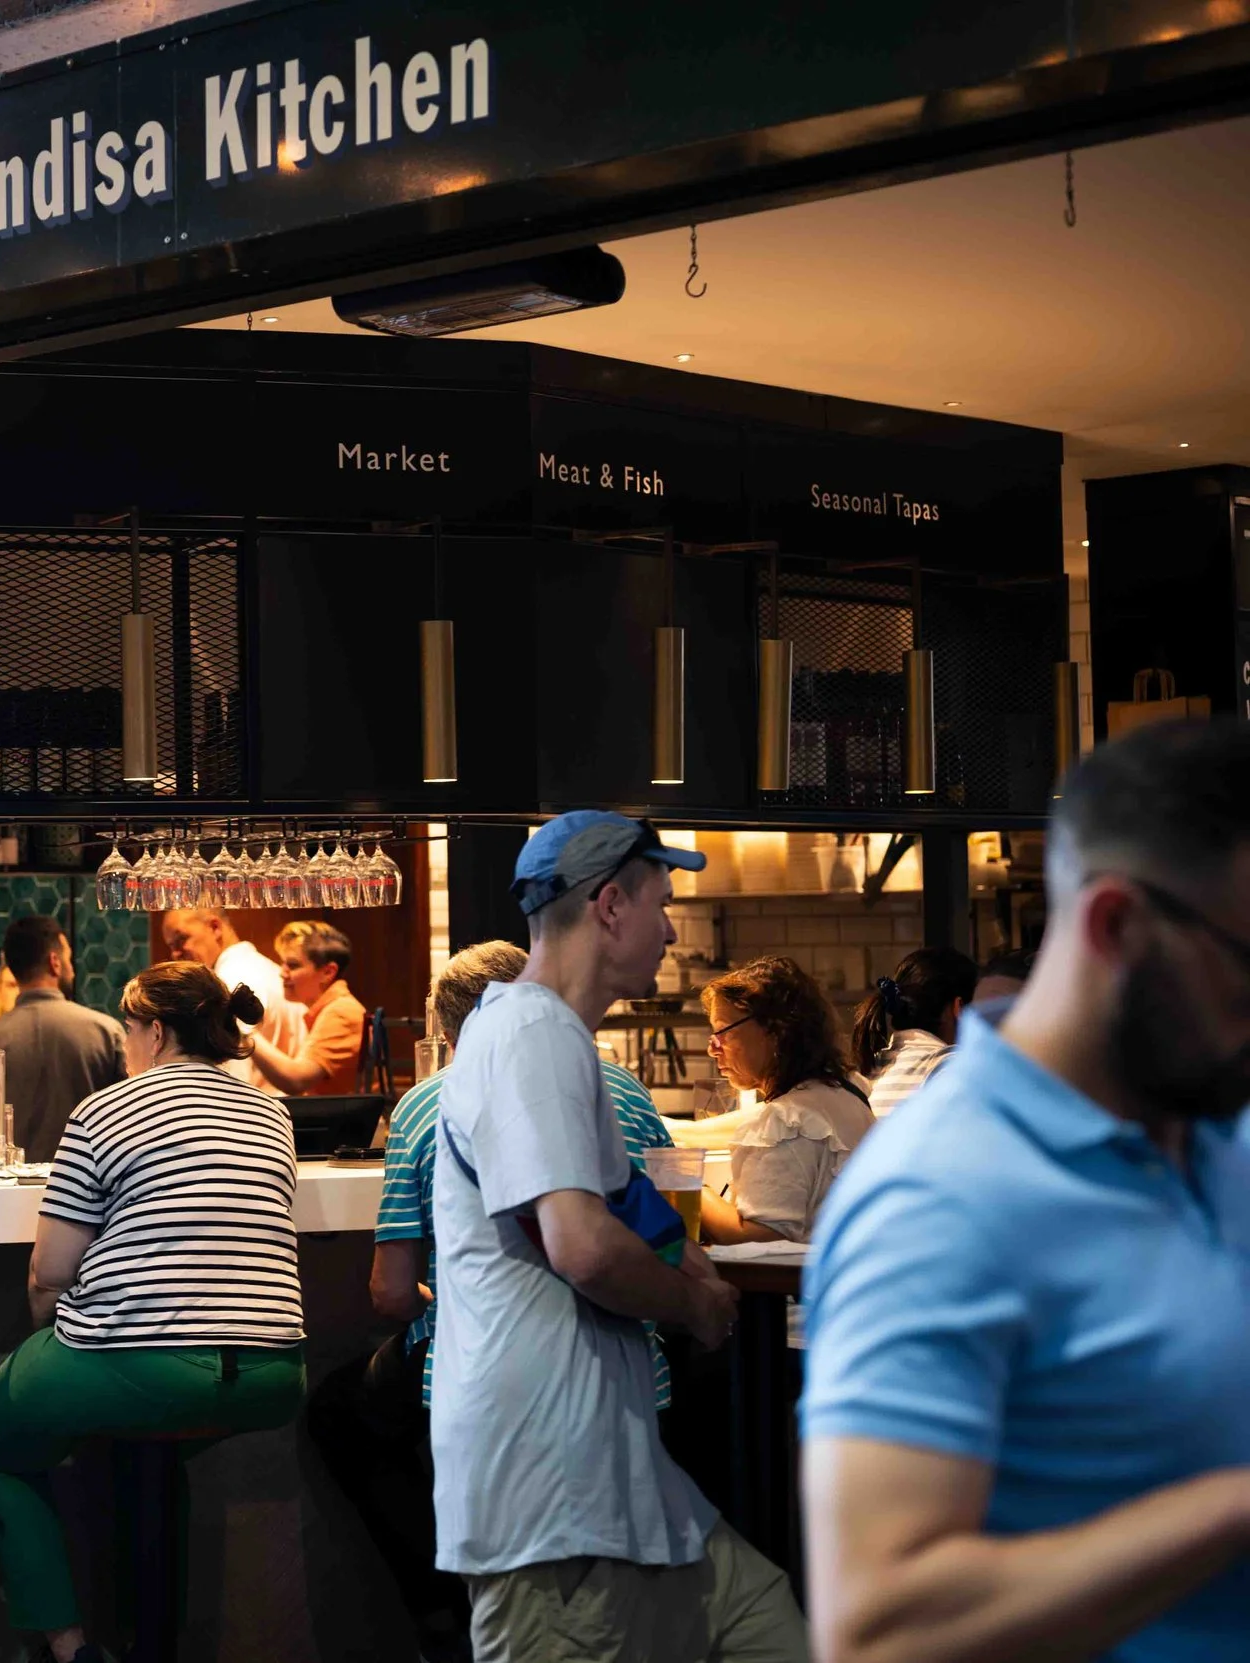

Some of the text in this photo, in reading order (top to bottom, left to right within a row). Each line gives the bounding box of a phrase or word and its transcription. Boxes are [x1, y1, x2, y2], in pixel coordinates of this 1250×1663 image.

[204, 35, 491, 184] Kitchen
[338, 442, 450, 472] Market
[539, 452, 664, 496] Meat & Fish
[811, 483, 939, 526] Seasonal Tapas
